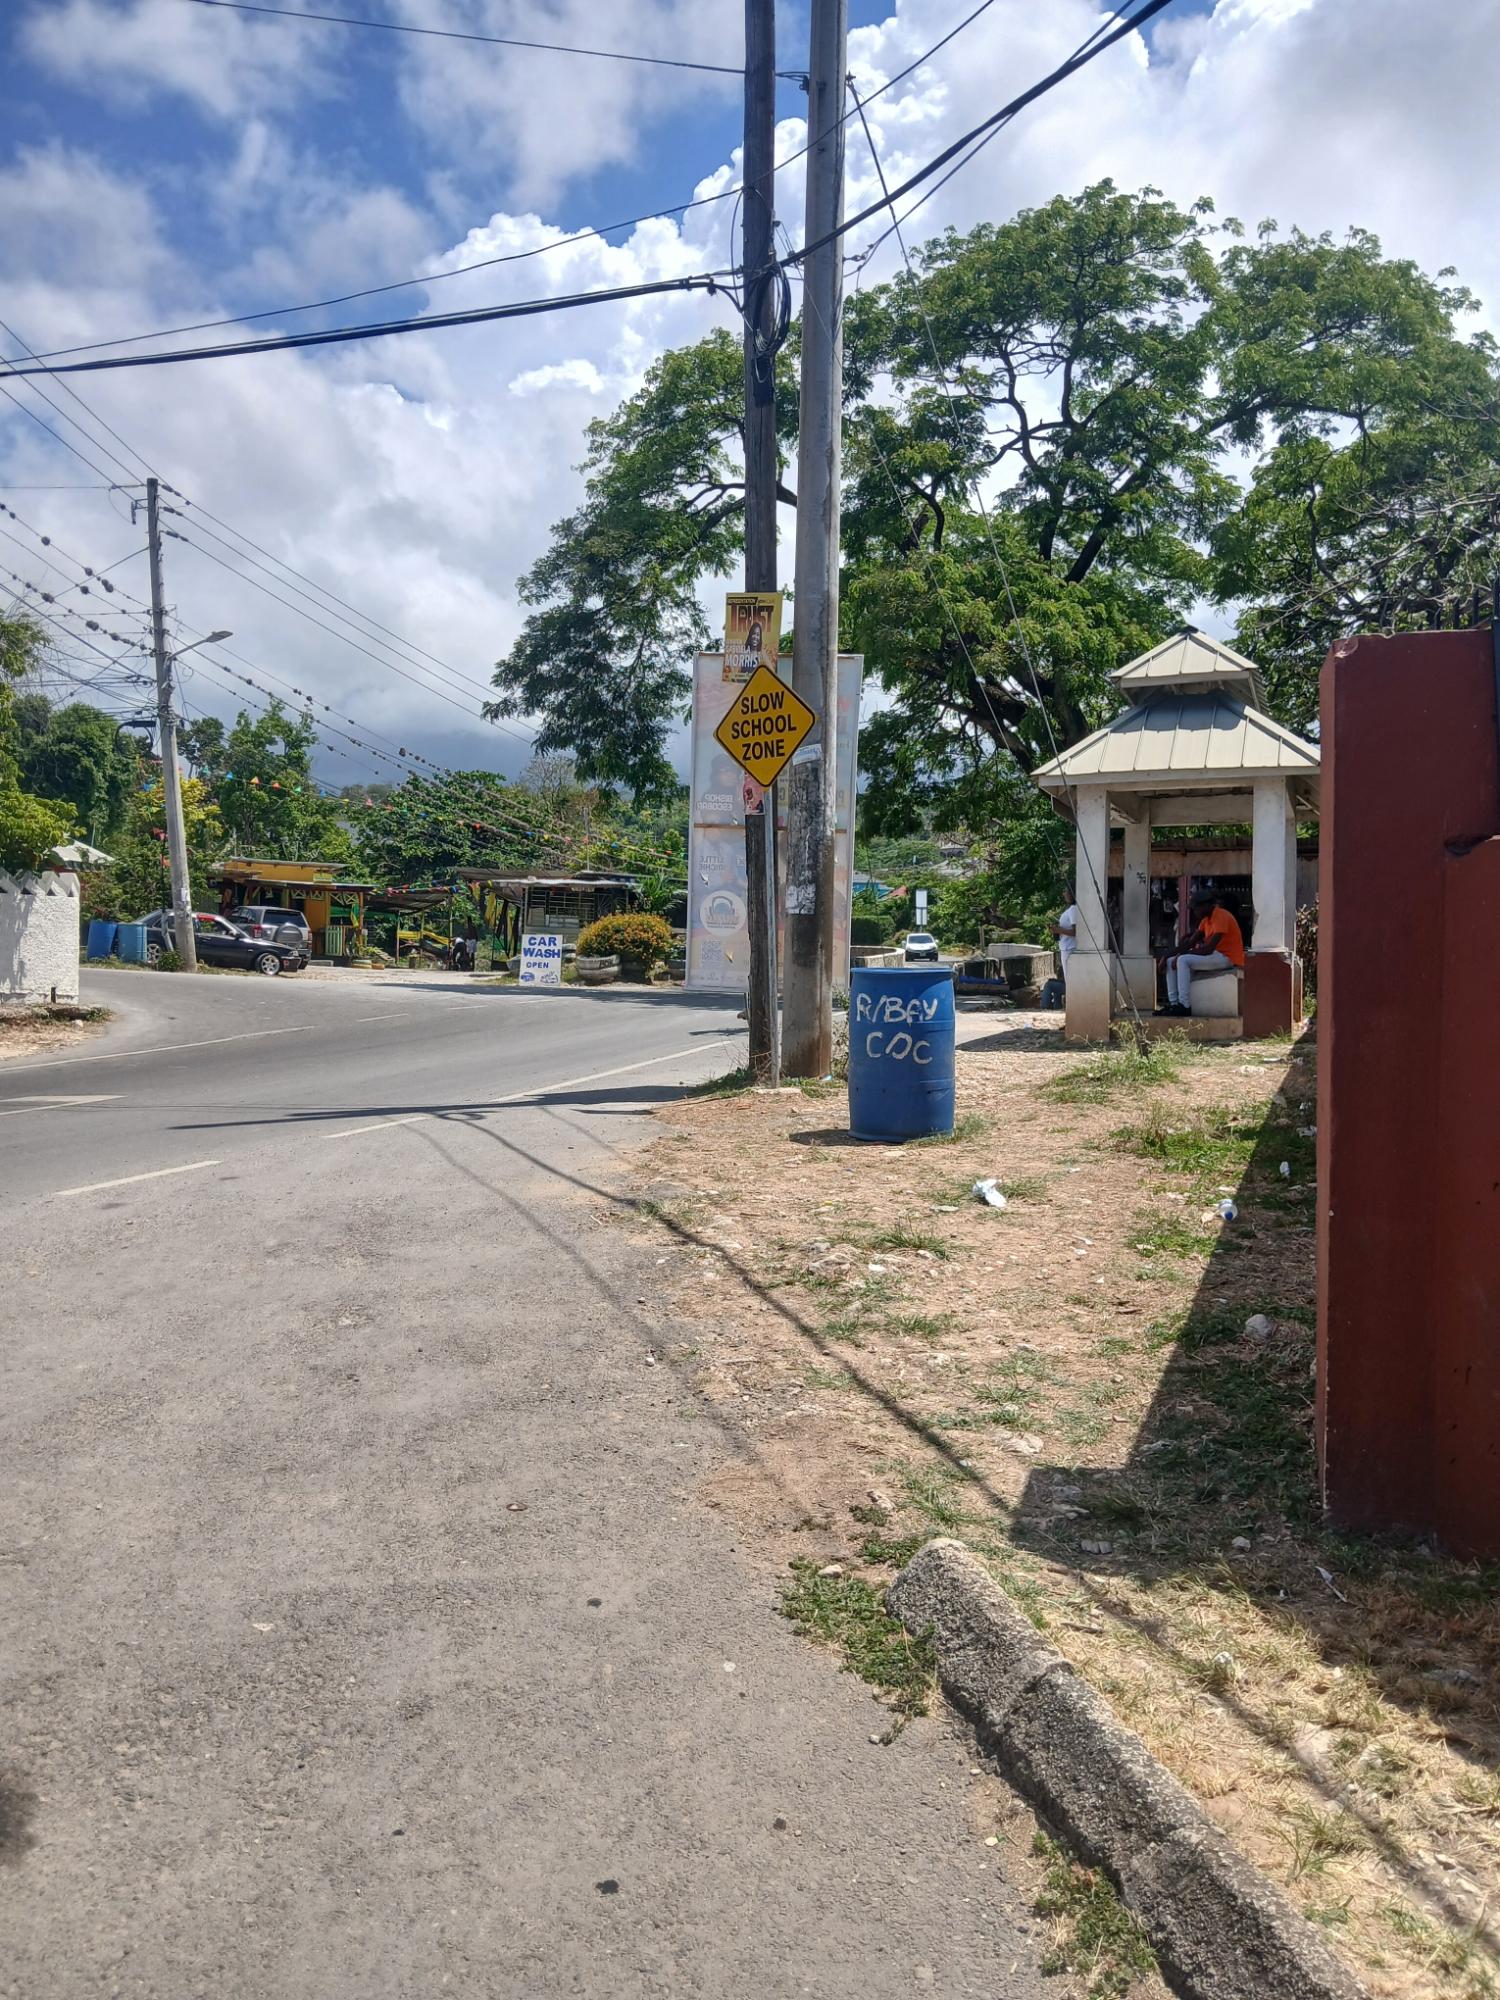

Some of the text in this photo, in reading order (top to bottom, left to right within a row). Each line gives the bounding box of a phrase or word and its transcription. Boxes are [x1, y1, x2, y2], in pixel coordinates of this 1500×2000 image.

[730, 604, 774, 633] TRUST
[741, 691, 784, 715] SLOW
[731, 714, 797, 739] SCHOOL
[742, 738, 785, 760] ZONE
[528, 936, 557, 946] CAR
[523, 947, 561, 958] WASH
[526, 961, 549, 969] OPEN
